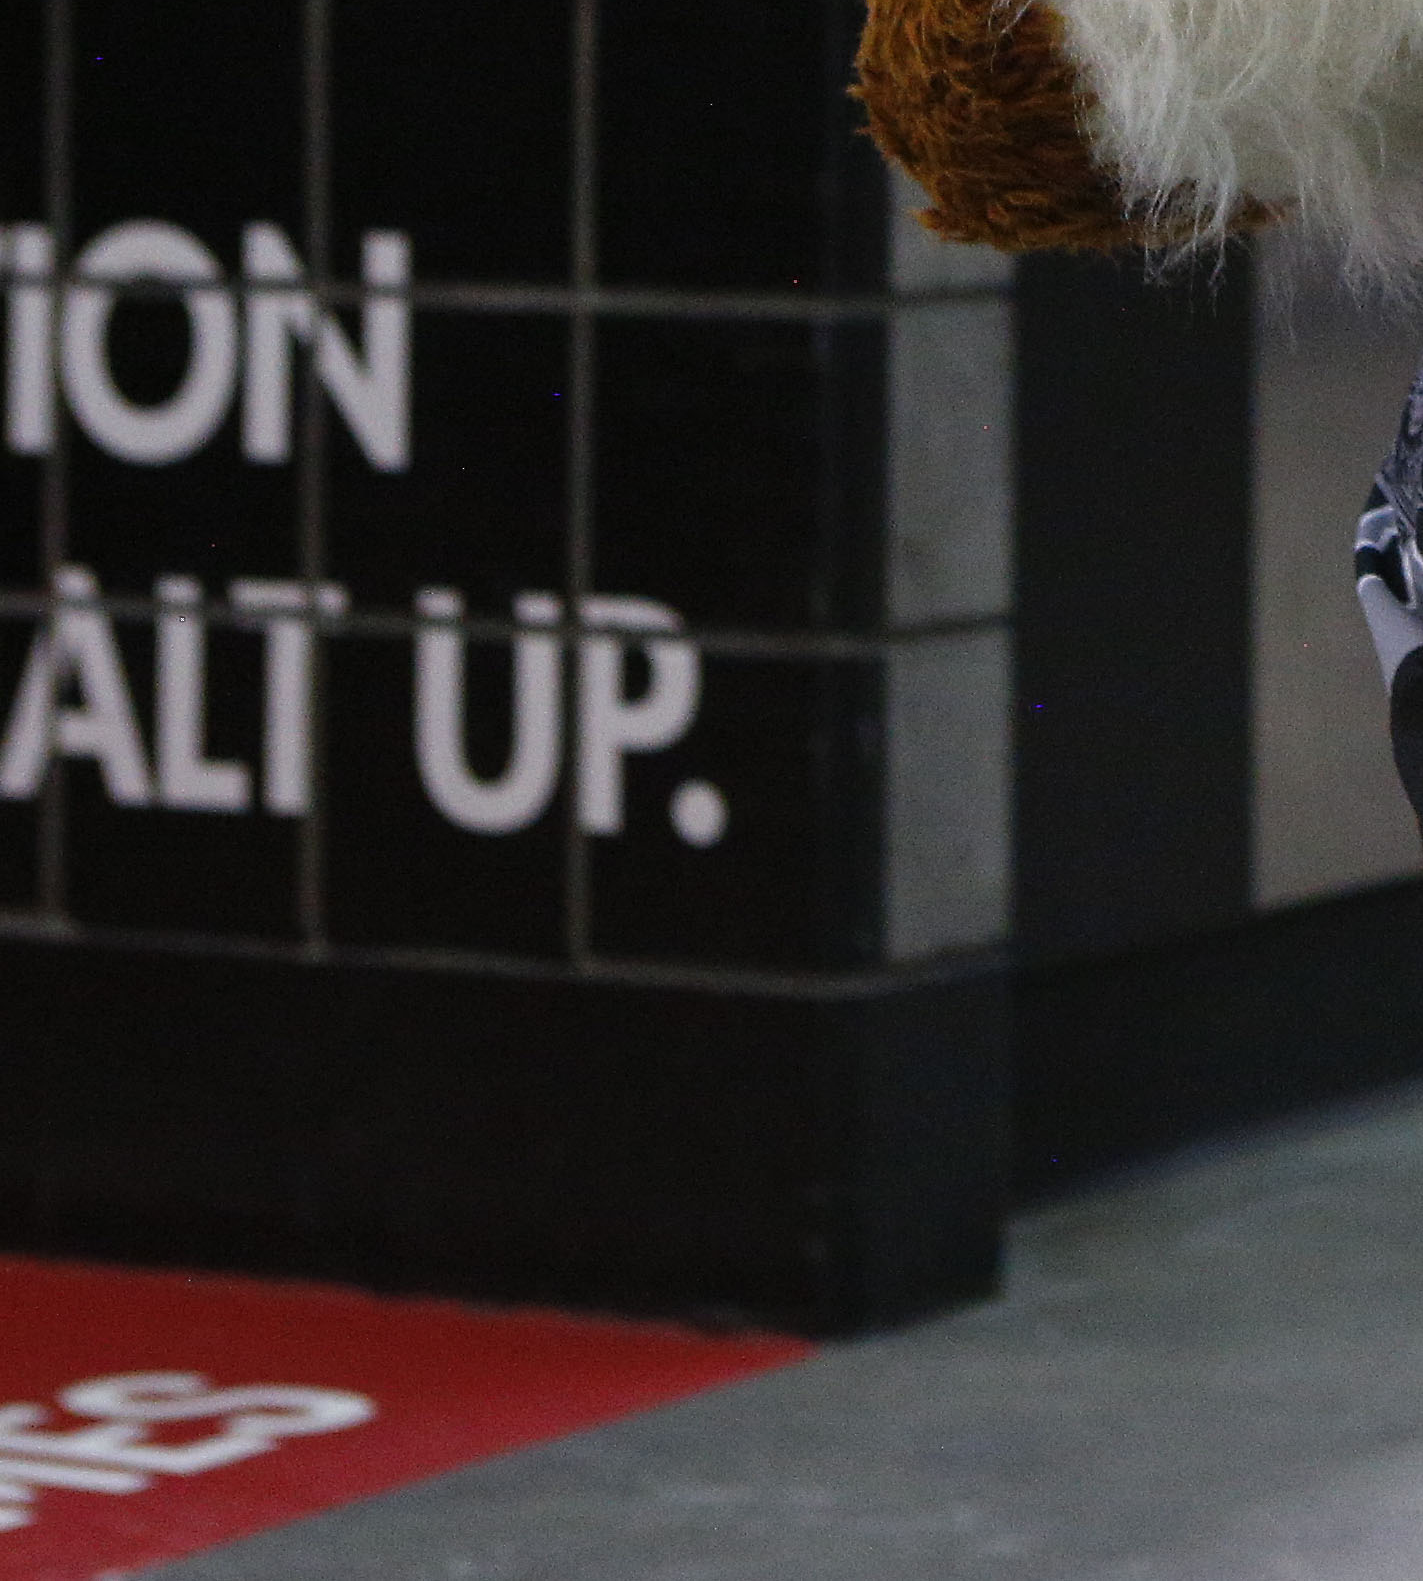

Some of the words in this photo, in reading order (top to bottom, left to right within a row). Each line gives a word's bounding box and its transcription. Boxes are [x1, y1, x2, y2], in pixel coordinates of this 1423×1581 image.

[0, 220, 412, 474] ION
[0, 564, 350, 815] ALT
[414, 585, 728, 847] UP.
